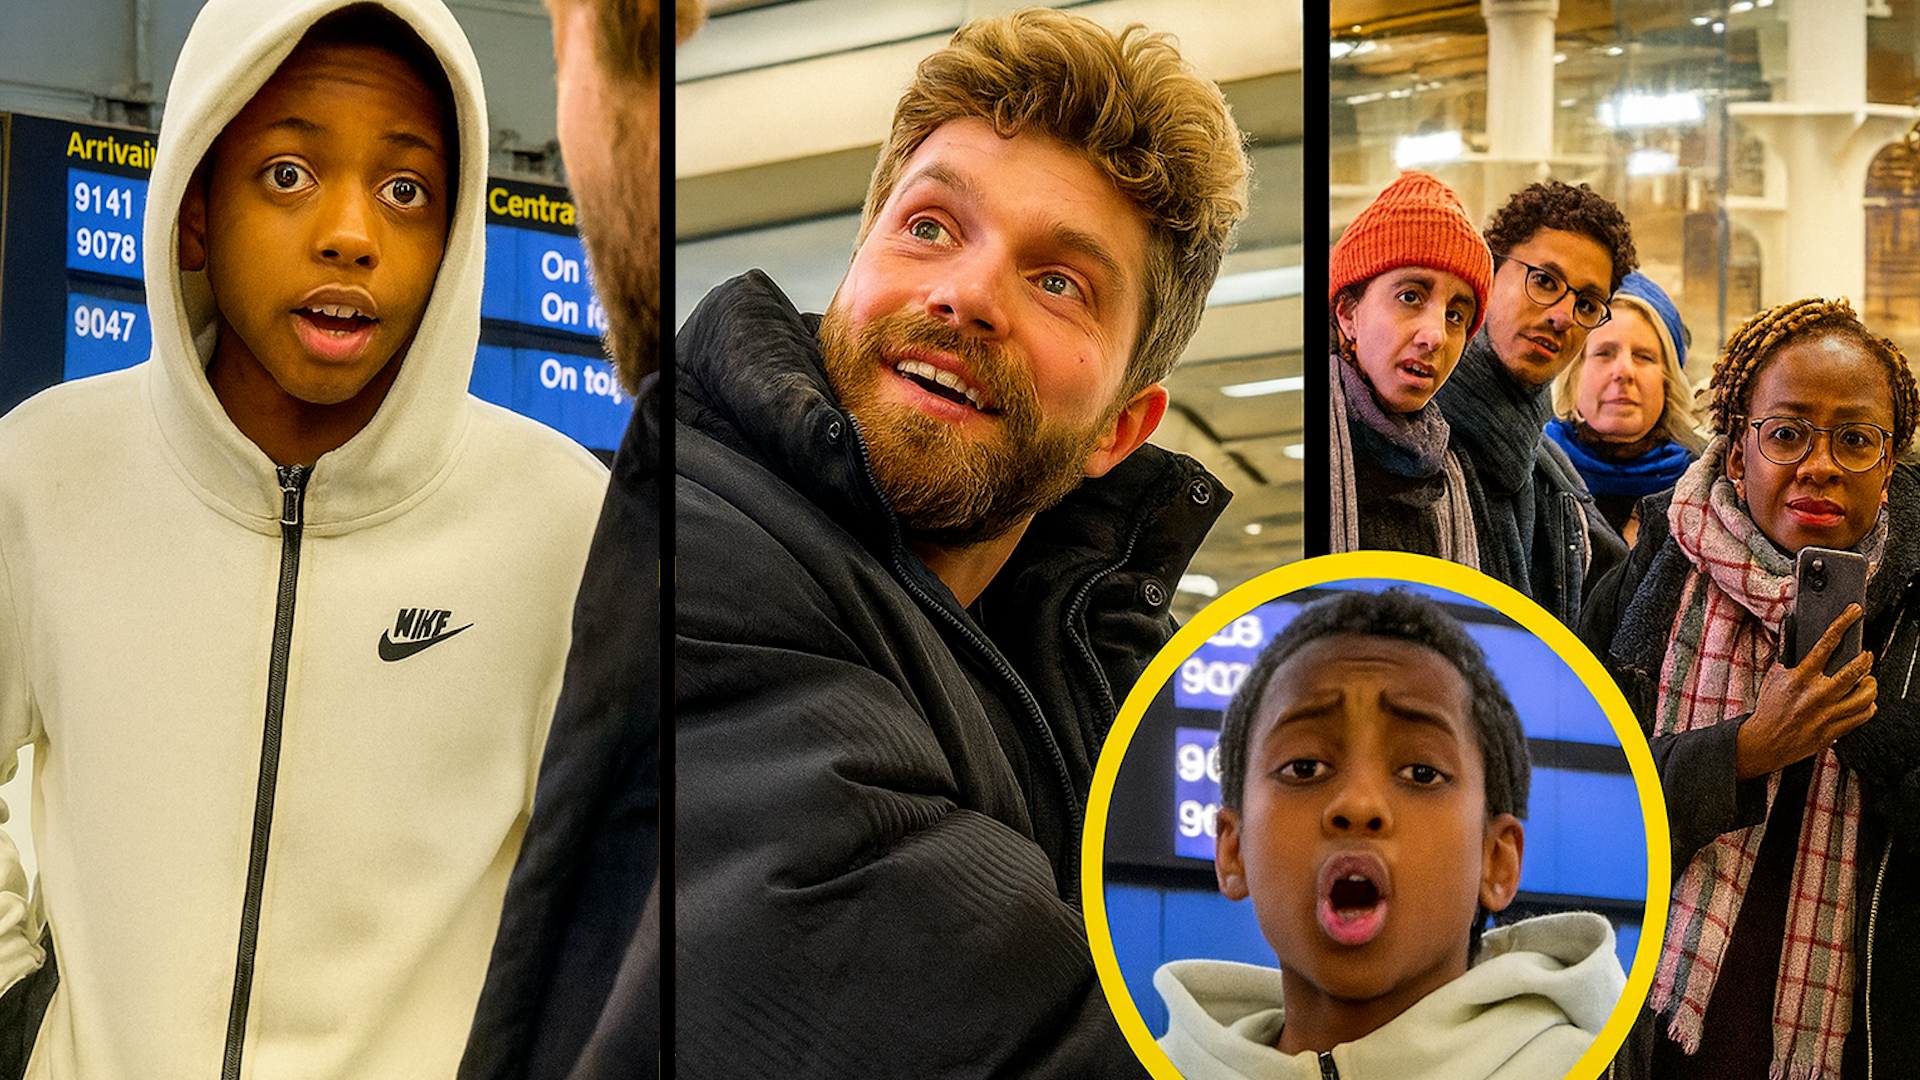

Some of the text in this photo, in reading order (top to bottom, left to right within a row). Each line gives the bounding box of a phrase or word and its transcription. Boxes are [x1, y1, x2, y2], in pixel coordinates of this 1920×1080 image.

[74, 182, 131, 219] 9141
[76, 228, 136, 264] 9078
[541, 250, 579, 284] On
[74, 306, 136, 342] 9047
[541, 292, 579, 326] On
[540, 358, 577, 391] On
